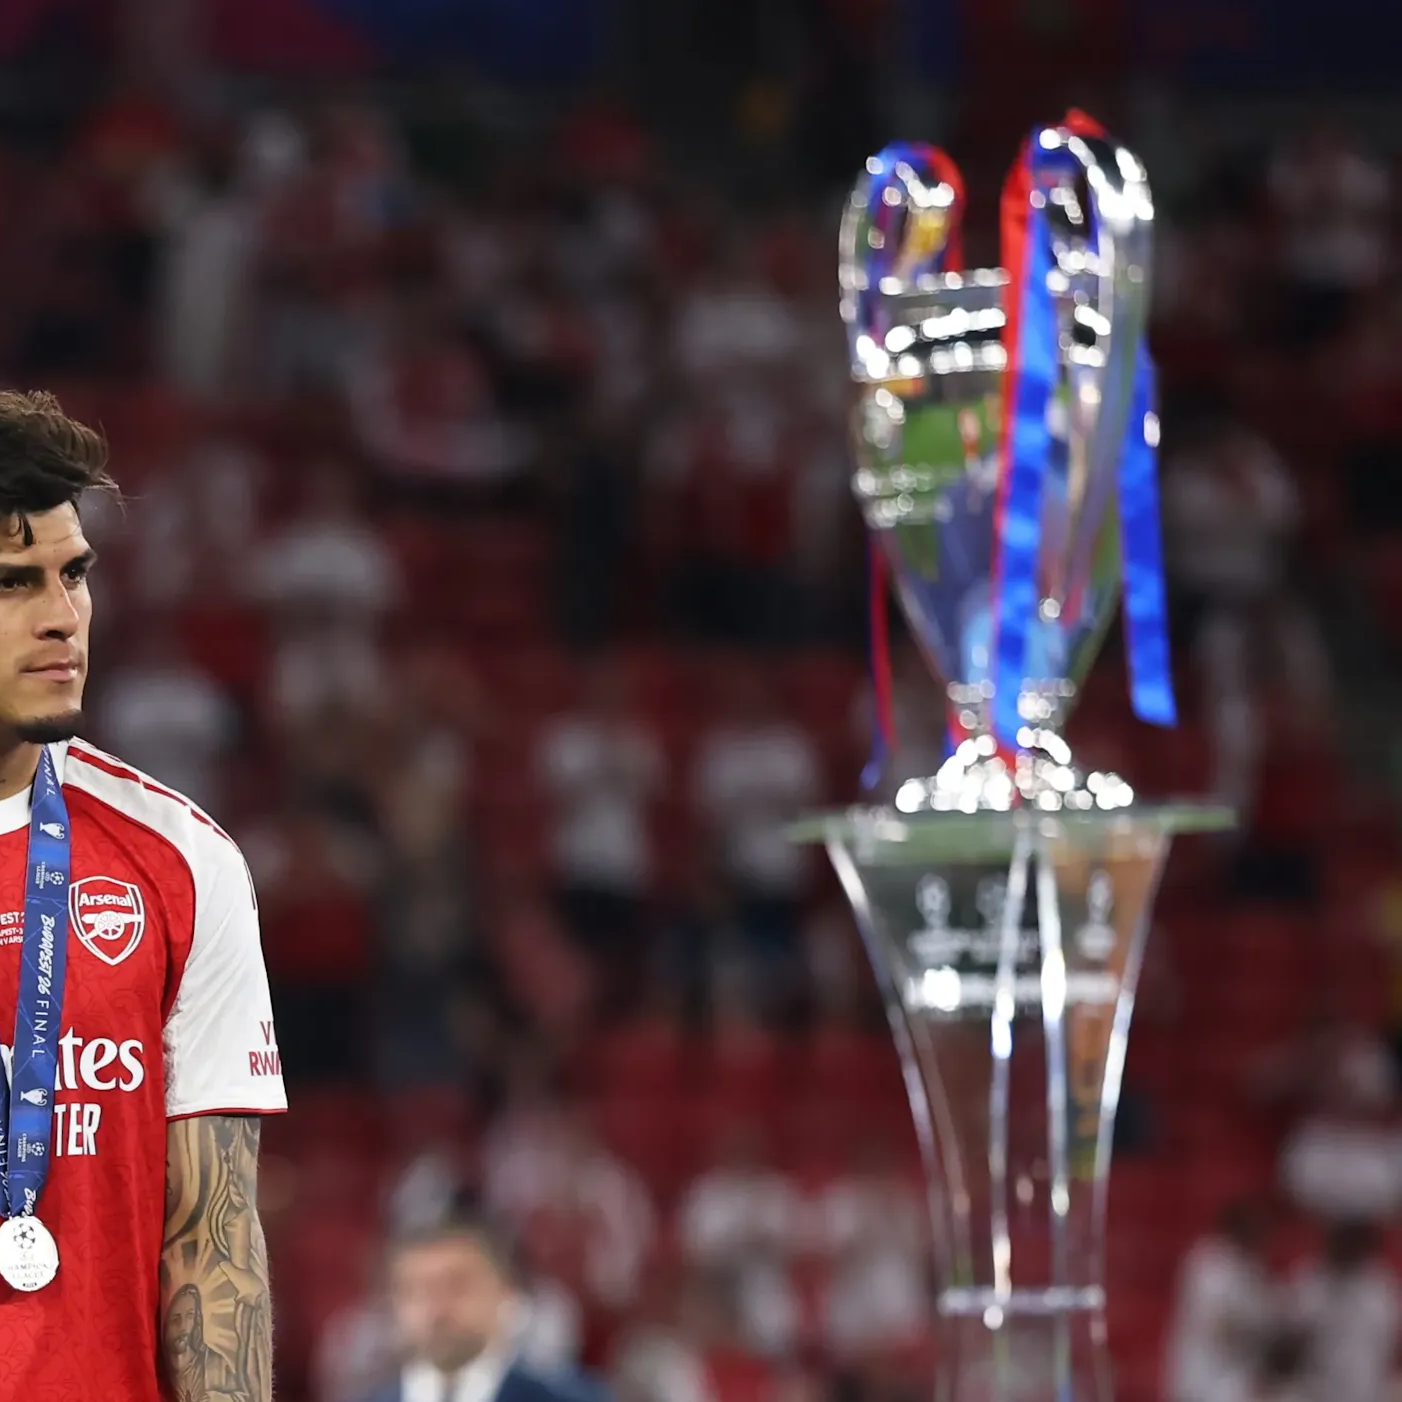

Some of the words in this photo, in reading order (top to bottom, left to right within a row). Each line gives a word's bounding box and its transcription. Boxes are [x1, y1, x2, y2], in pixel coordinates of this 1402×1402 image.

[79, 893, 133, 907] Arsenal
[38, 914, 55, 979] BUDAPEST
[37, 976, 51, 996] 26
[32, 1000, 49, 1058] FINAL
[53, 1102, 102, 1158] TER
